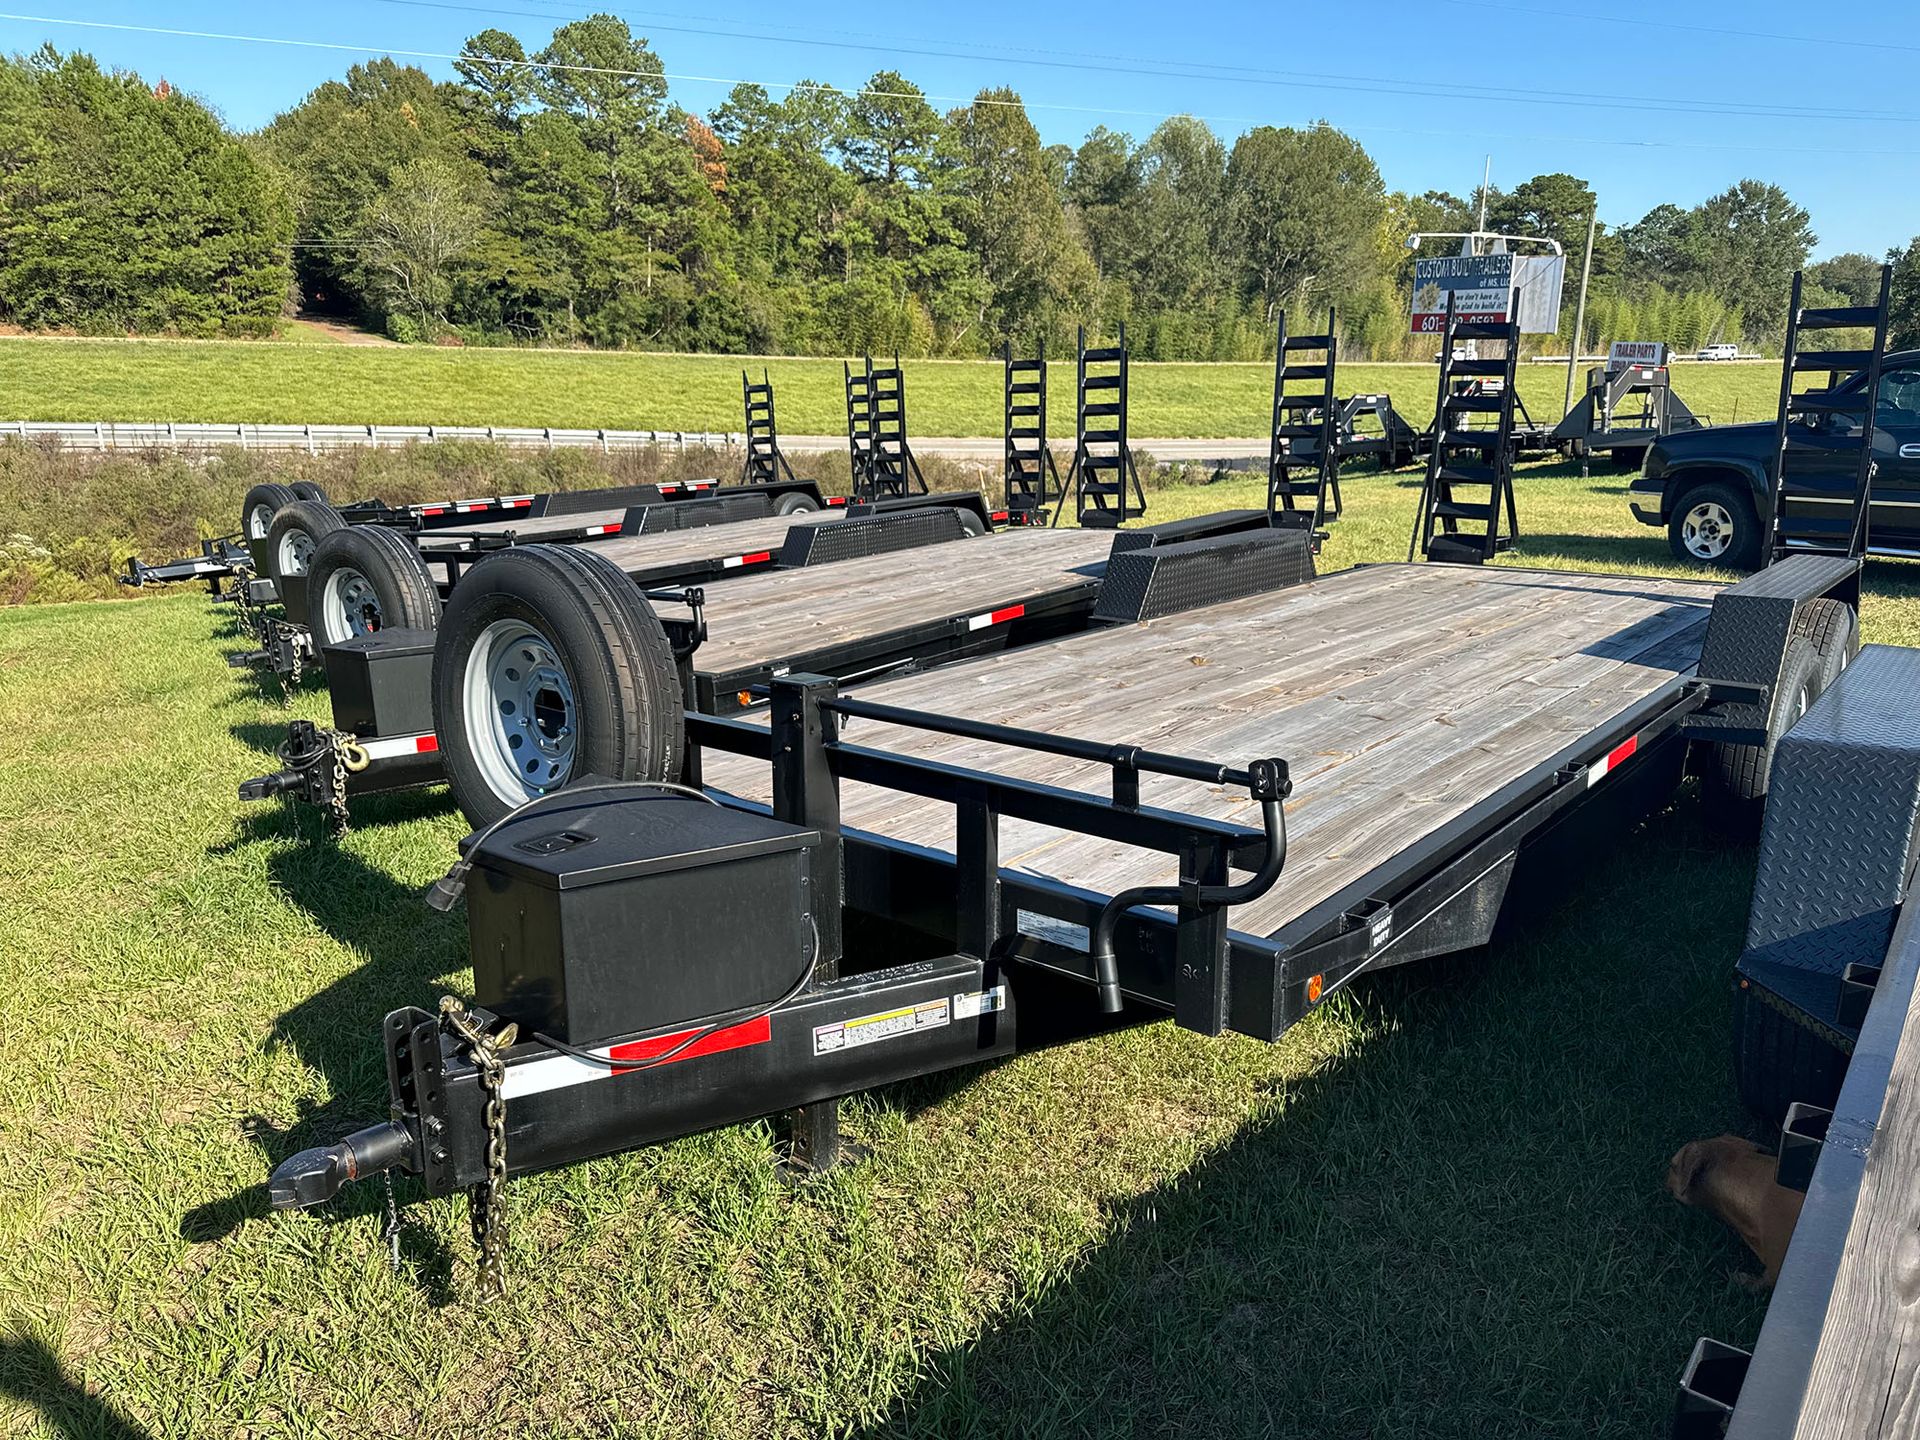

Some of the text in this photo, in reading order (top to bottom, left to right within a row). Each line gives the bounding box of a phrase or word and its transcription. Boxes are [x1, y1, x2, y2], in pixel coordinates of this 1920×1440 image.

[1417, 256, 1511, 279] CUSTOM BUILT TRAILERS
[1480, 292, 1492, 300] have
[1461, 302, 1474, 311] glad
[1481, 301, 1496, 309] build
[1615, 344, 1656, 359] TRAILER PARTS
[1372, 914, 1393, 936] HEAVY
[1373, 928, 1390, 947] DUTY
